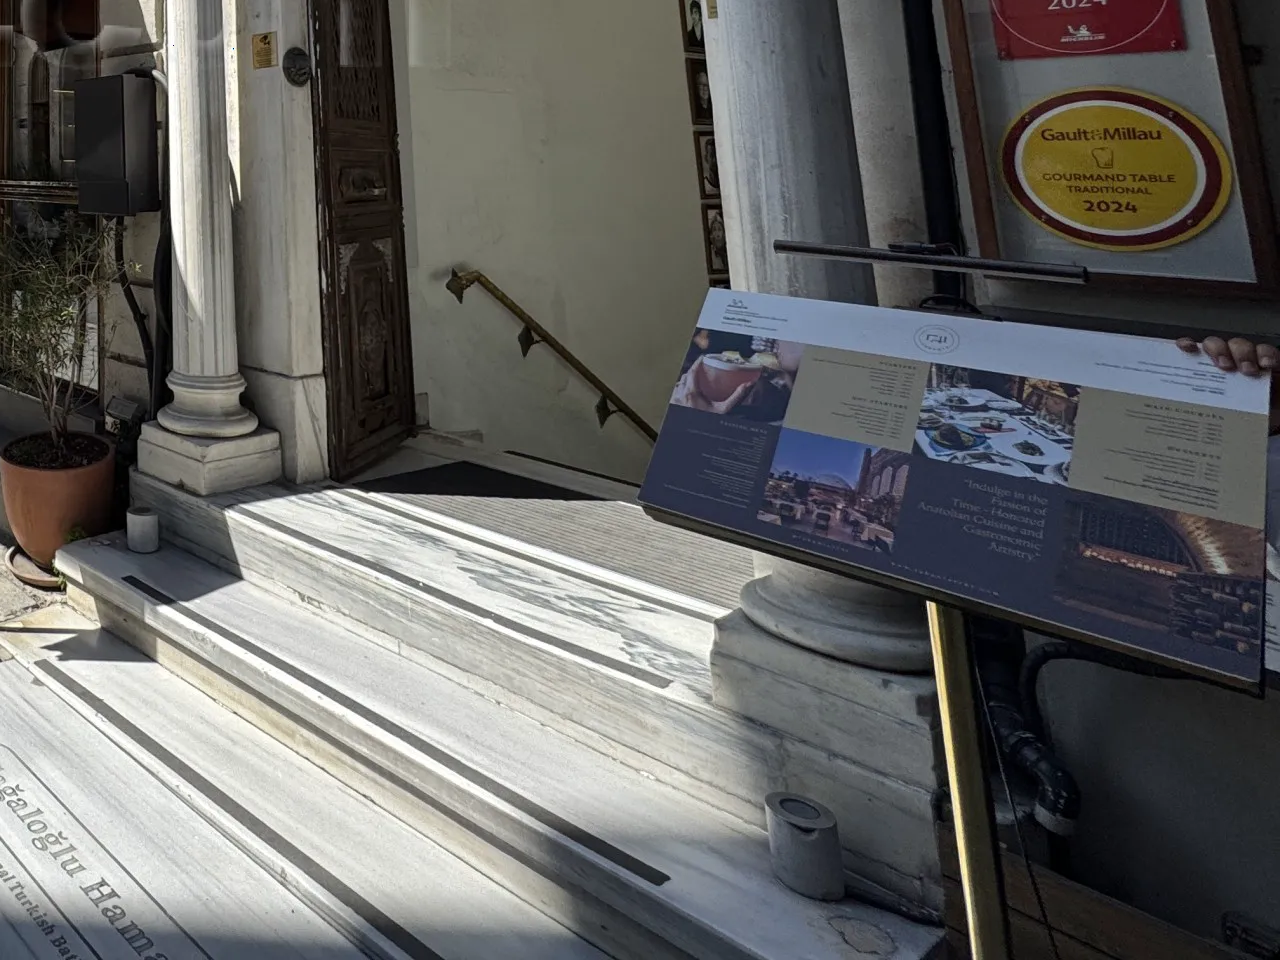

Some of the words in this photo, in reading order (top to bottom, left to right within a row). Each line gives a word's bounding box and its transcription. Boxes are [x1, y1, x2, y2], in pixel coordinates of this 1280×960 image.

[1042, 173, 1126, 182] GOURMAND
[1129, 174, 1176, 183] TABLE
[1066, 185, 1152, 195] TRADITIONAL
[1083, 200, 1138, 213] 2024
[952, 499, 981, 512] Time
[992, 496, 1031, 512] Fusion
[1028, 495, 1048, 505] the
[918, 502, 970, 521] Anatolian
[974, 516, 1018, 533] Cuisine
[1020, 527, 1043, 539] and
[9, 881, 56, 937] Turkish
